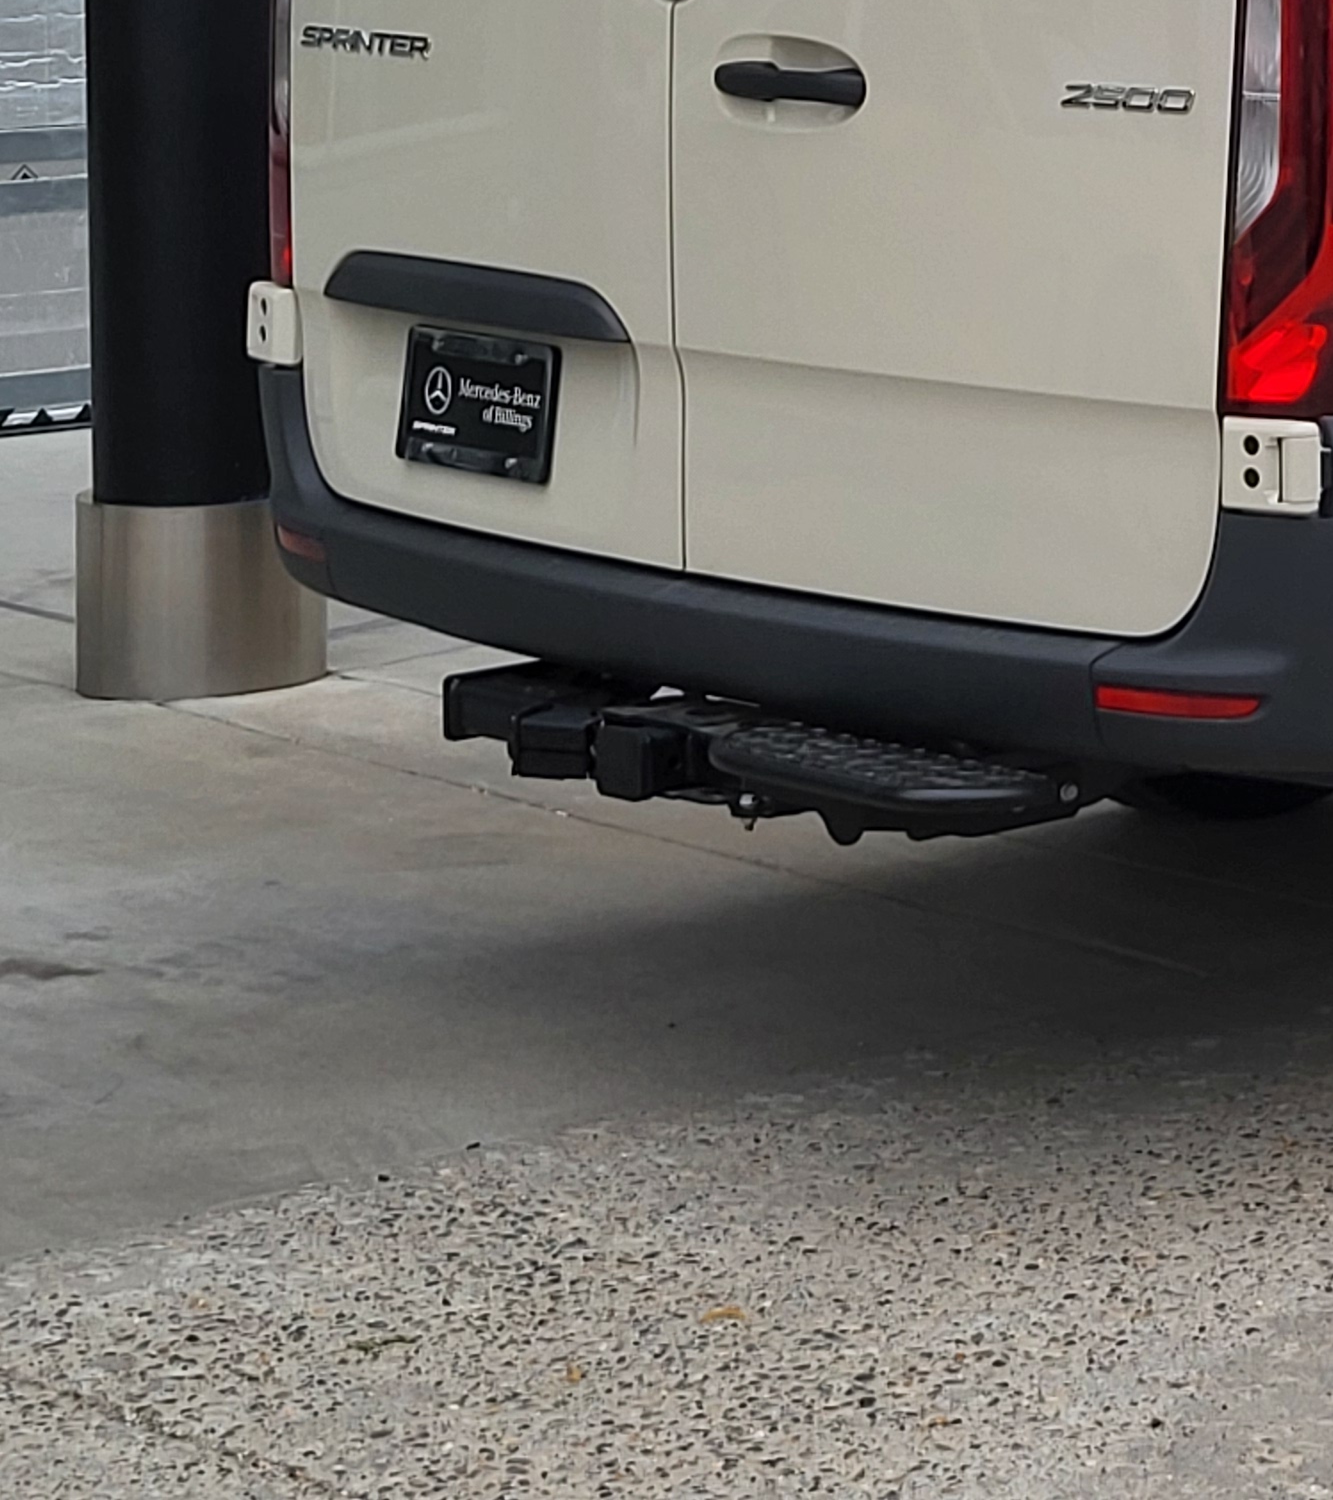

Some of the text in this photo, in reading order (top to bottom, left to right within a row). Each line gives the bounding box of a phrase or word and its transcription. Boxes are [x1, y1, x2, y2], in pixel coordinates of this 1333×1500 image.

[300, 24, 431, 61] SPRINTER
[1060, 83, 1196, 115] 2500
[458, 377, 541, 409] Mercedes-Benz
[482, 405, 533, 432] of Billings
